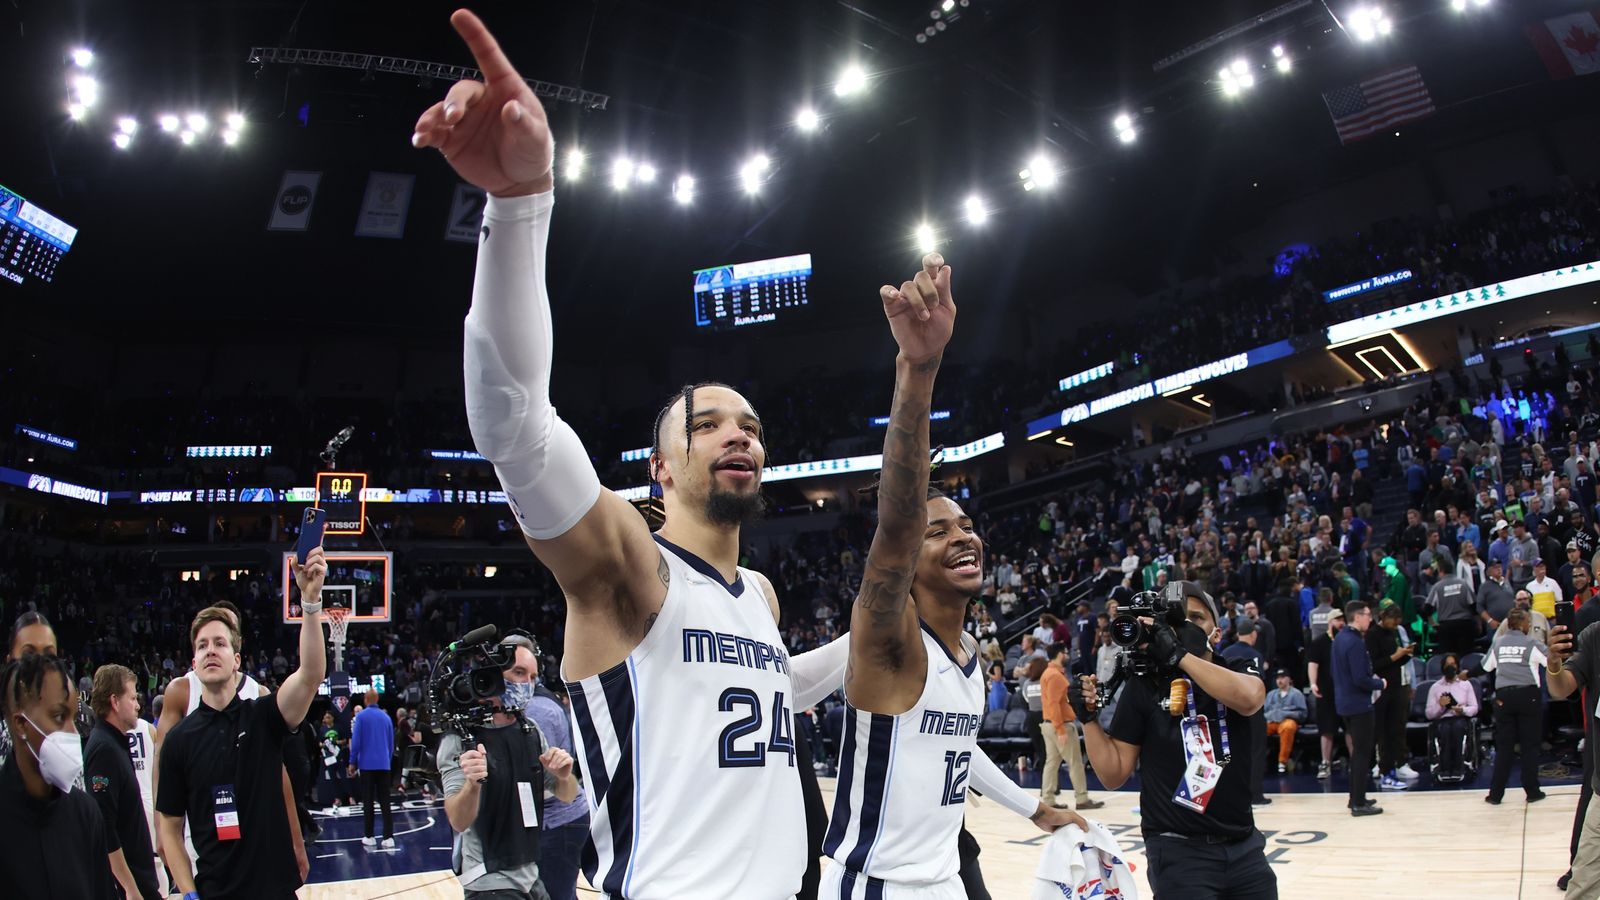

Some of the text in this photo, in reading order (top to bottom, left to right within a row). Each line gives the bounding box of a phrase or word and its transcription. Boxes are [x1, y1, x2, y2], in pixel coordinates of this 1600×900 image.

[282, 195, 308, 205] FLIP
[1089, 352, 1248, 416] MINNESOTA TIMBERWOLVES
[331, 478, 352, 493] 0.0
[52, 480, 100, 504] MINNESOTA
[171, 490, 193, 502] BACK
[329, 521, 360, 529] TISSOT
[1444, 583, 1463, 591] BEST
[1498, 645, 1527, 655] BEST
[718, 686, 795, 768] 24
[940, 750, 972, 806] 12
[215, 796, 233, 805] MEDIA
